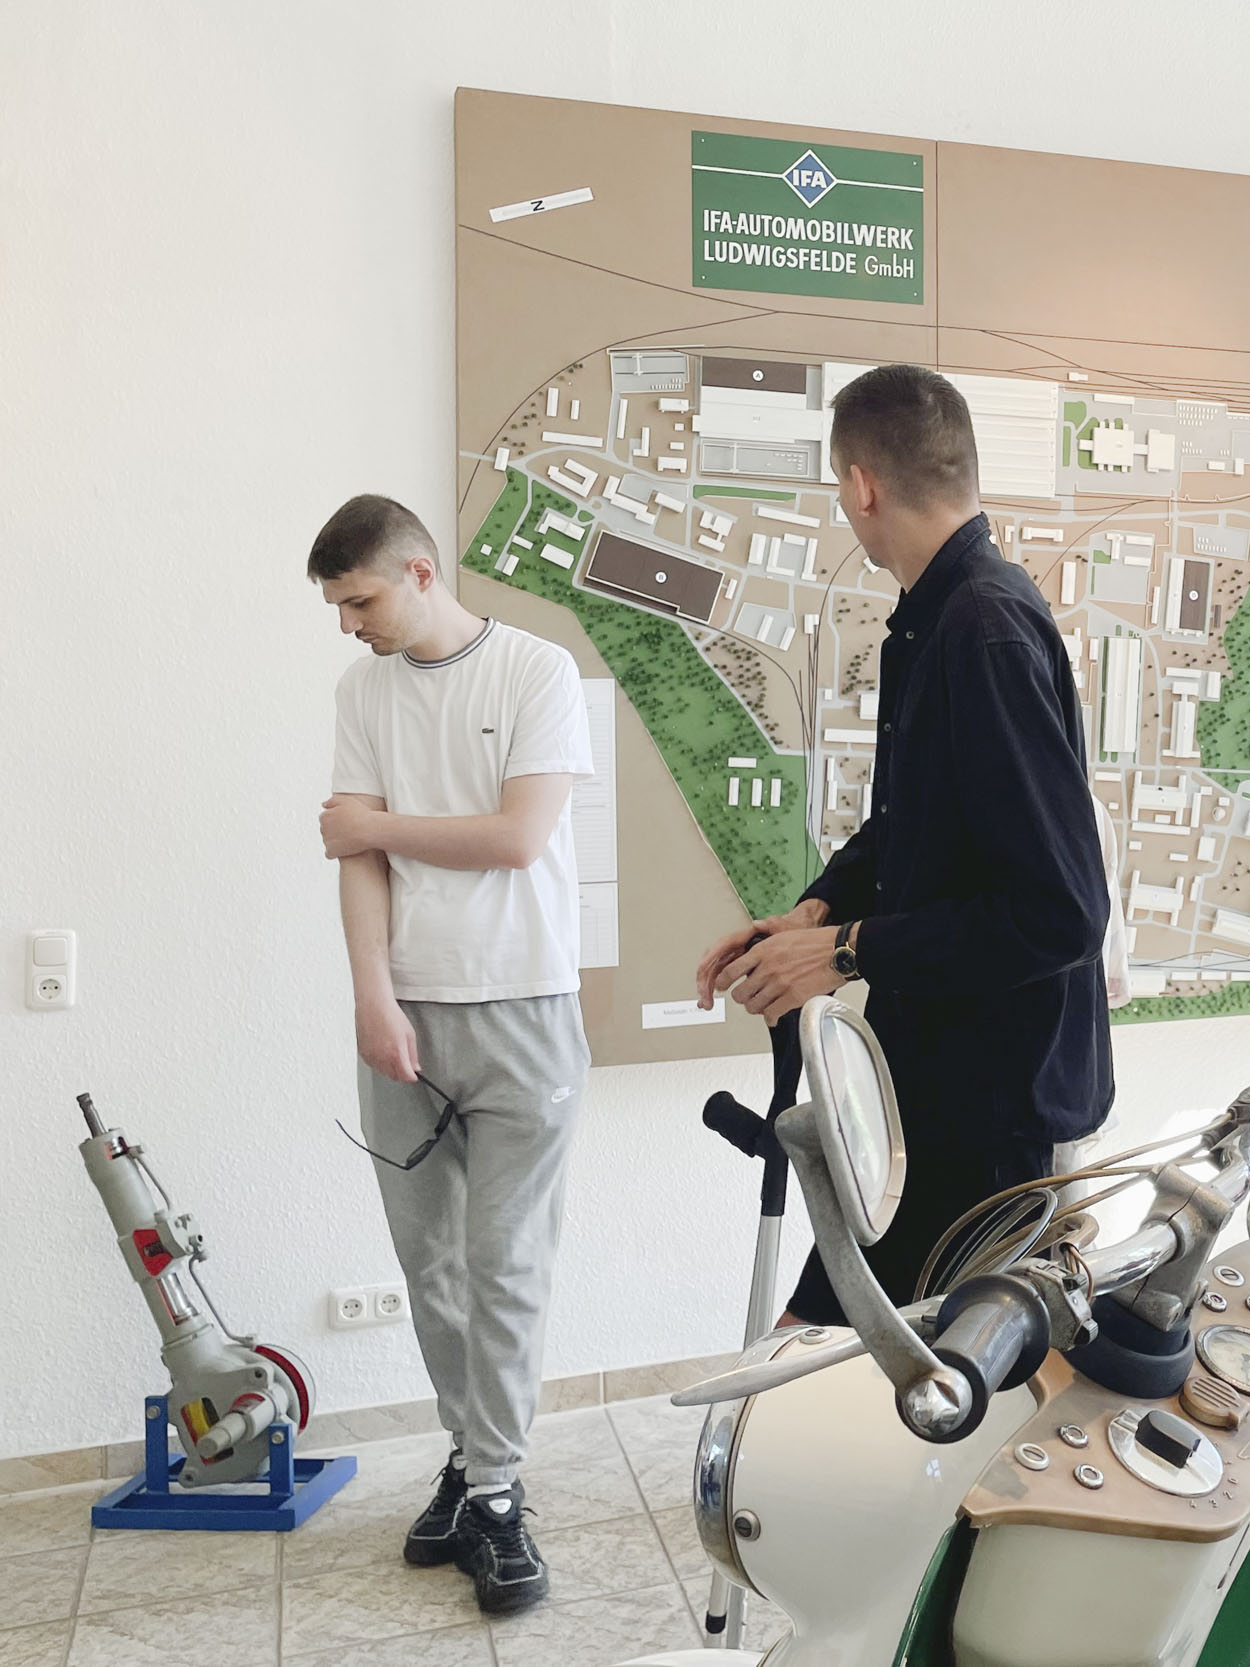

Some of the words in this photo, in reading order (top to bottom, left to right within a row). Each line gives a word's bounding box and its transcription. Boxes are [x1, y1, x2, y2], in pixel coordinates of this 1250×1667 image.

[792, 169, 828, 189] IFA
[703, 209, 914, 251] IFA-AUTOMOBILWERK
[703, 239, 857, 274] LUDWIGSFELDE
[864, 253, 914, 279] GmbH
